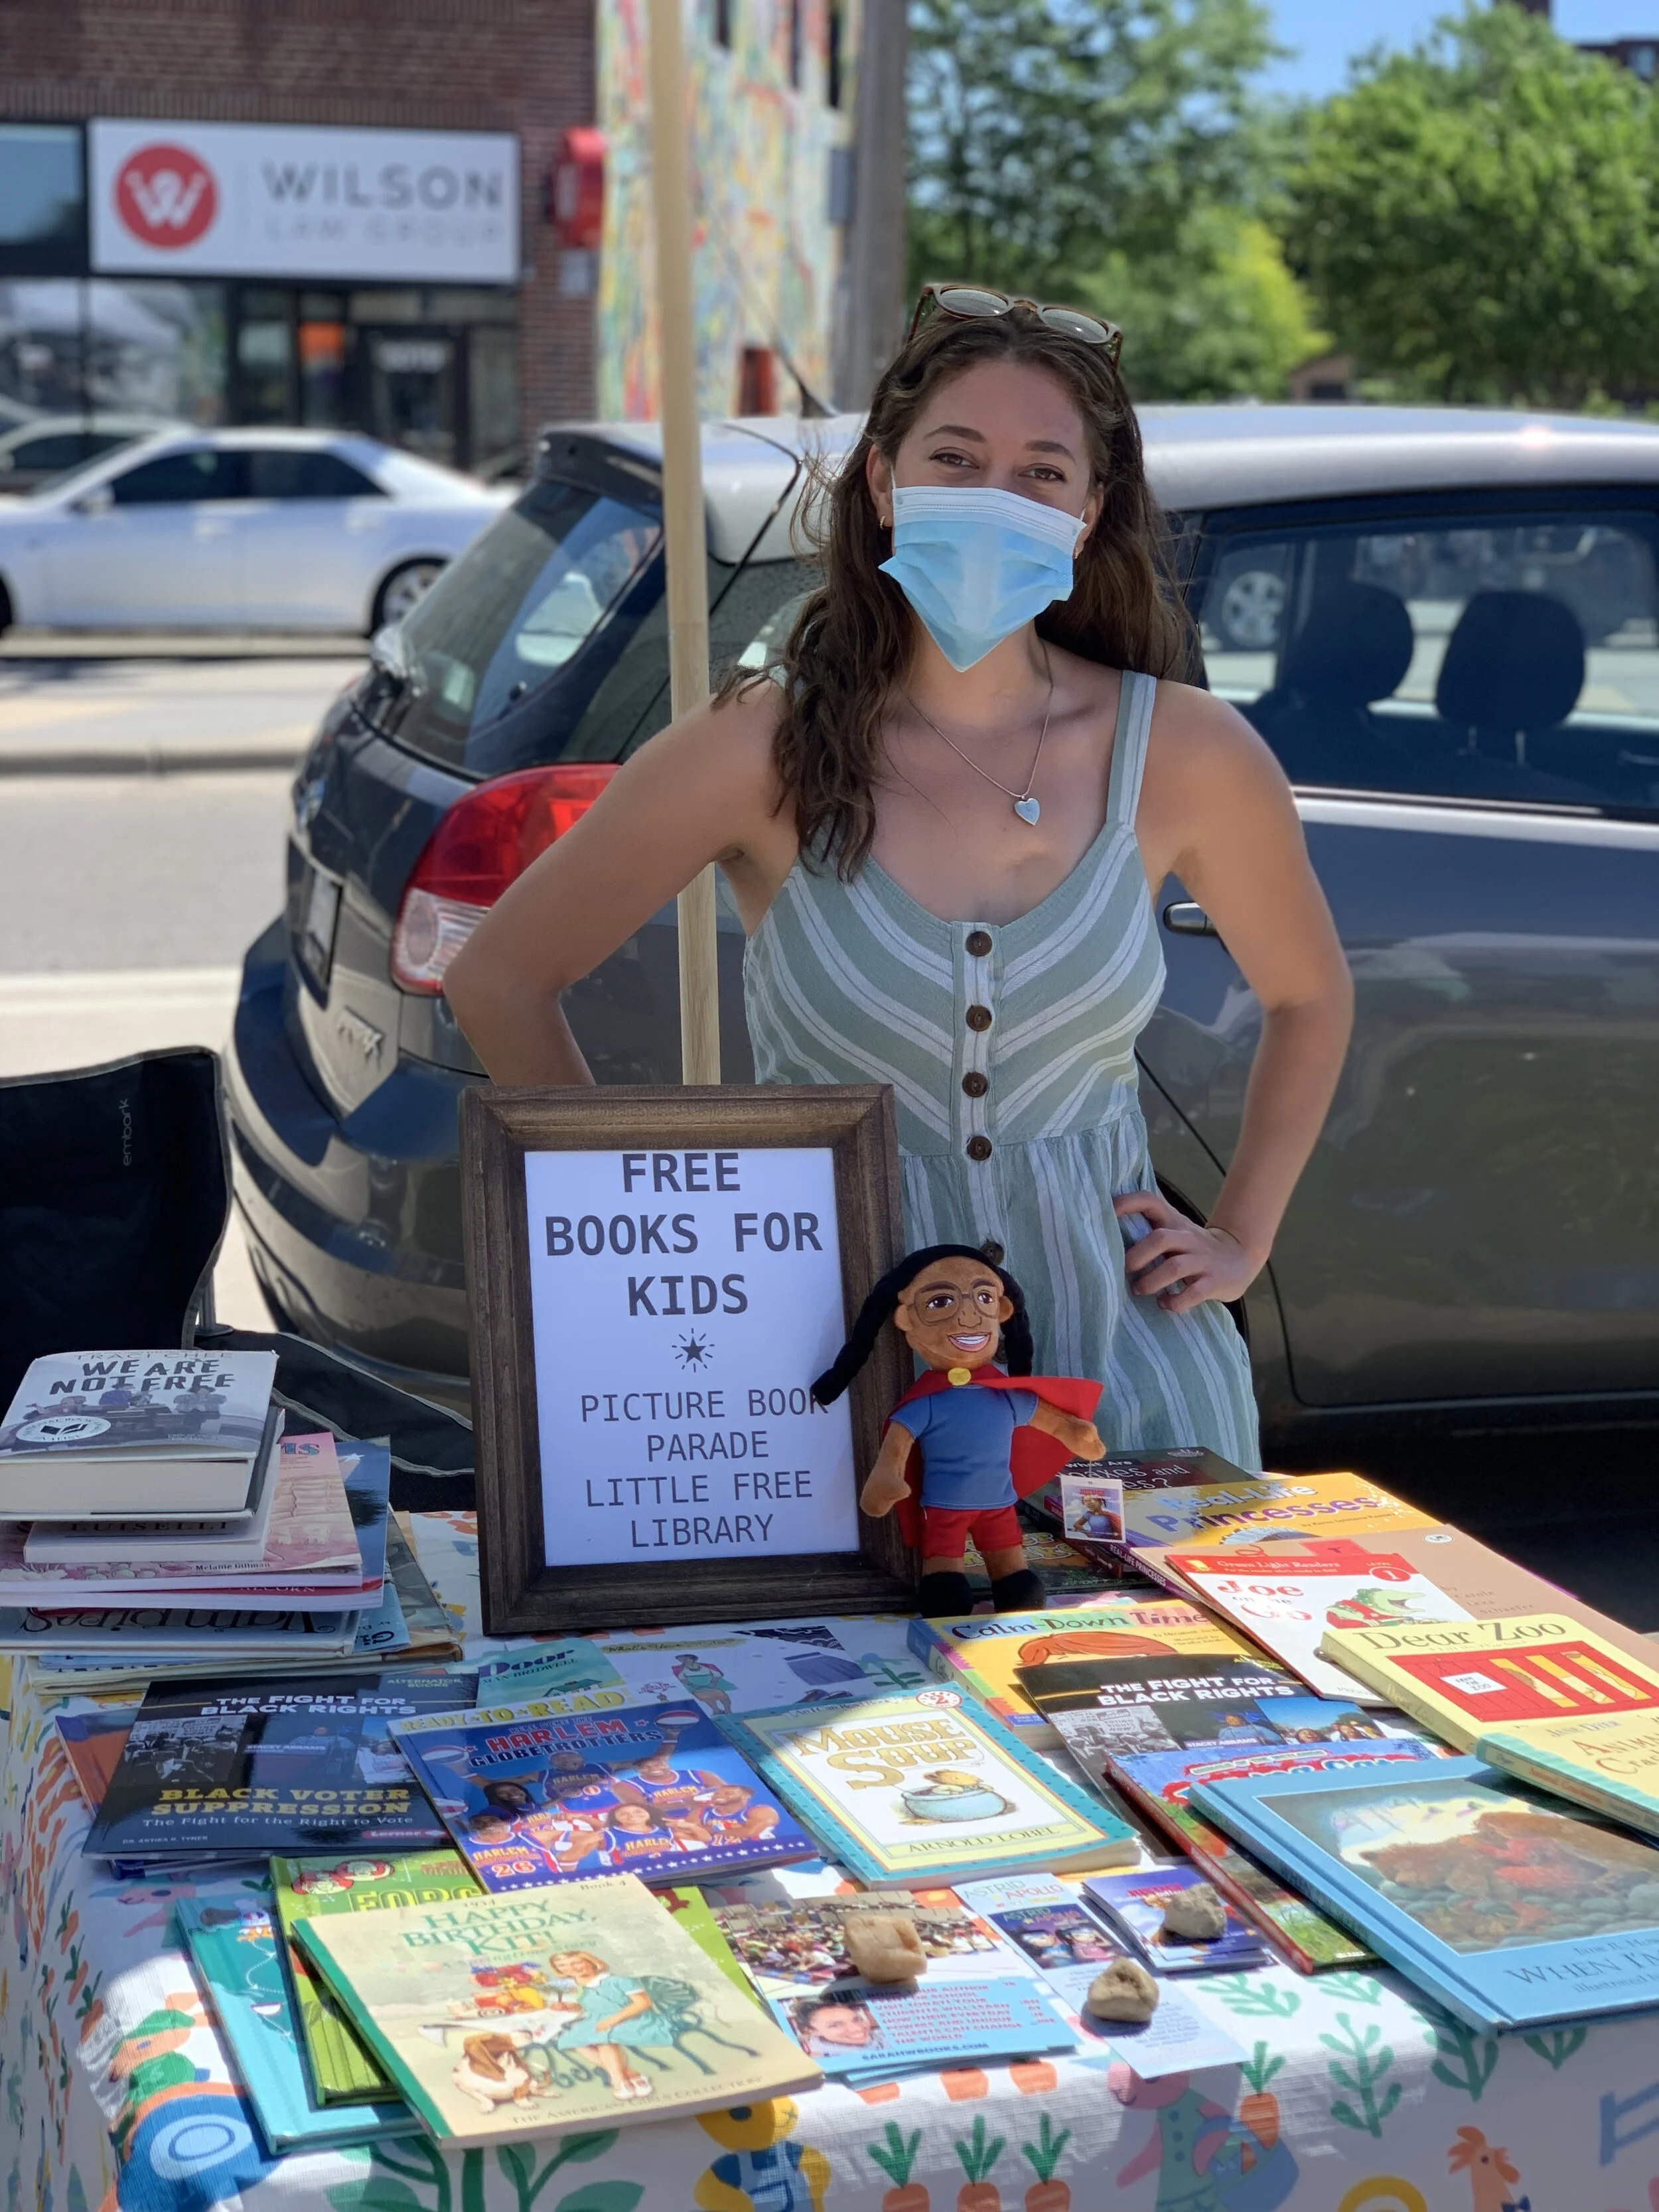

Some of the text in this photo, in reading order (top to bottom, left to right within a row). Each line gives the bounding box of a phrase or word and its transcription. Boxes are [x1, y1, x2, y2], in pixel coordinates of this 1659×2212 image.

[261, 162, 502, 210] WILSON
[265, 215, 502, 248] LAW GROUP
[119, 1098, 132, 1166] embark
[622, 1152, 741, 1193] FREE
[545, 1212, 824, 1256] BOOKS FOR
[628, 1275, 749, 1316] KIDS
[82, 1359, 221, 1376] WE ARE
[49, 1373, 236, 1395] NOT FREE
[581, 1390, 725, 1422] PICTURE
[647, 1431, 769, 1462] PARADE
[1056, 1464, 1190, 1479] oaxes and
[1122, 1477, 1172, 1491] es?
[586, 1471, 813, 1507] LITTLE FREE
[1153, 1480, 1319, 1512] Real-Life
[1145, 1497, 1383, 1534] Princesses
[631, 1514, 774, 1548] LIBRARY
[195, 1562, 271, 1572] Melanie Gillman
[1110, 1544, 1135, 1567] REAL-LIFE
[1135, 1560, 1167, 1587] PRINCESSES
[1218, 1580, 1305, 1597] Joe
[952, 1611, 1211, 1640] Calm-Down Time
[1352, 1622, 1566, 1650] Dear Zoo
[478, 1650, 575, 1678] Door
[513, 1659, 577, 1678] BRIDWELL
[1097, 1684, 1296, 1706] BLACK RIGHTS
[1100, 1676, 1276, 1694] THE FIGHT FOR
[200, 1704, 417, 1716] BLACK RIGHTS
[268, 1695, 355, 1704] FIGHT
[929, 1693, 950, 1706] 2
[400, 1712, 465, 1733] READY
[476, 1708, 515, 1725] TO
[486, 1718, 629, 1753] HARLEM
[780, 1718, 968, 1757] MOUSE
[1185, 1736, 1258, 1748] STACEY ABRAMS
[469, 1730, 666, 1768] GLOBETROTTERS
[827, 1737, 978, 1791] SOUP
[159, 1788, 411, 1802] BLACK VOTER
[150, 1801, 412, 1816] SUPPRESSION
[143, 1815, 414, 1828] The Fight for the Right to Vote
[908, 1826, 1060, 1853] ARNOLD LOBEL
[472, 1845, 530, 1862] HARLEM
[491, 1860, 536, 1878] 26
[579, 1881, 616, 1891] Book
[964, 1880, 1027, 1900] ASTRID
[1005, 1883, 1064, 1900] APOLLO
[421, 1899, 551, 1929] HAPPY
[402, 1907, 599, 1948] BIRTHDAY,
[466, 1931, 559, 1956] KIT!
[1503, 1958, 1621, 1984] WHEN
